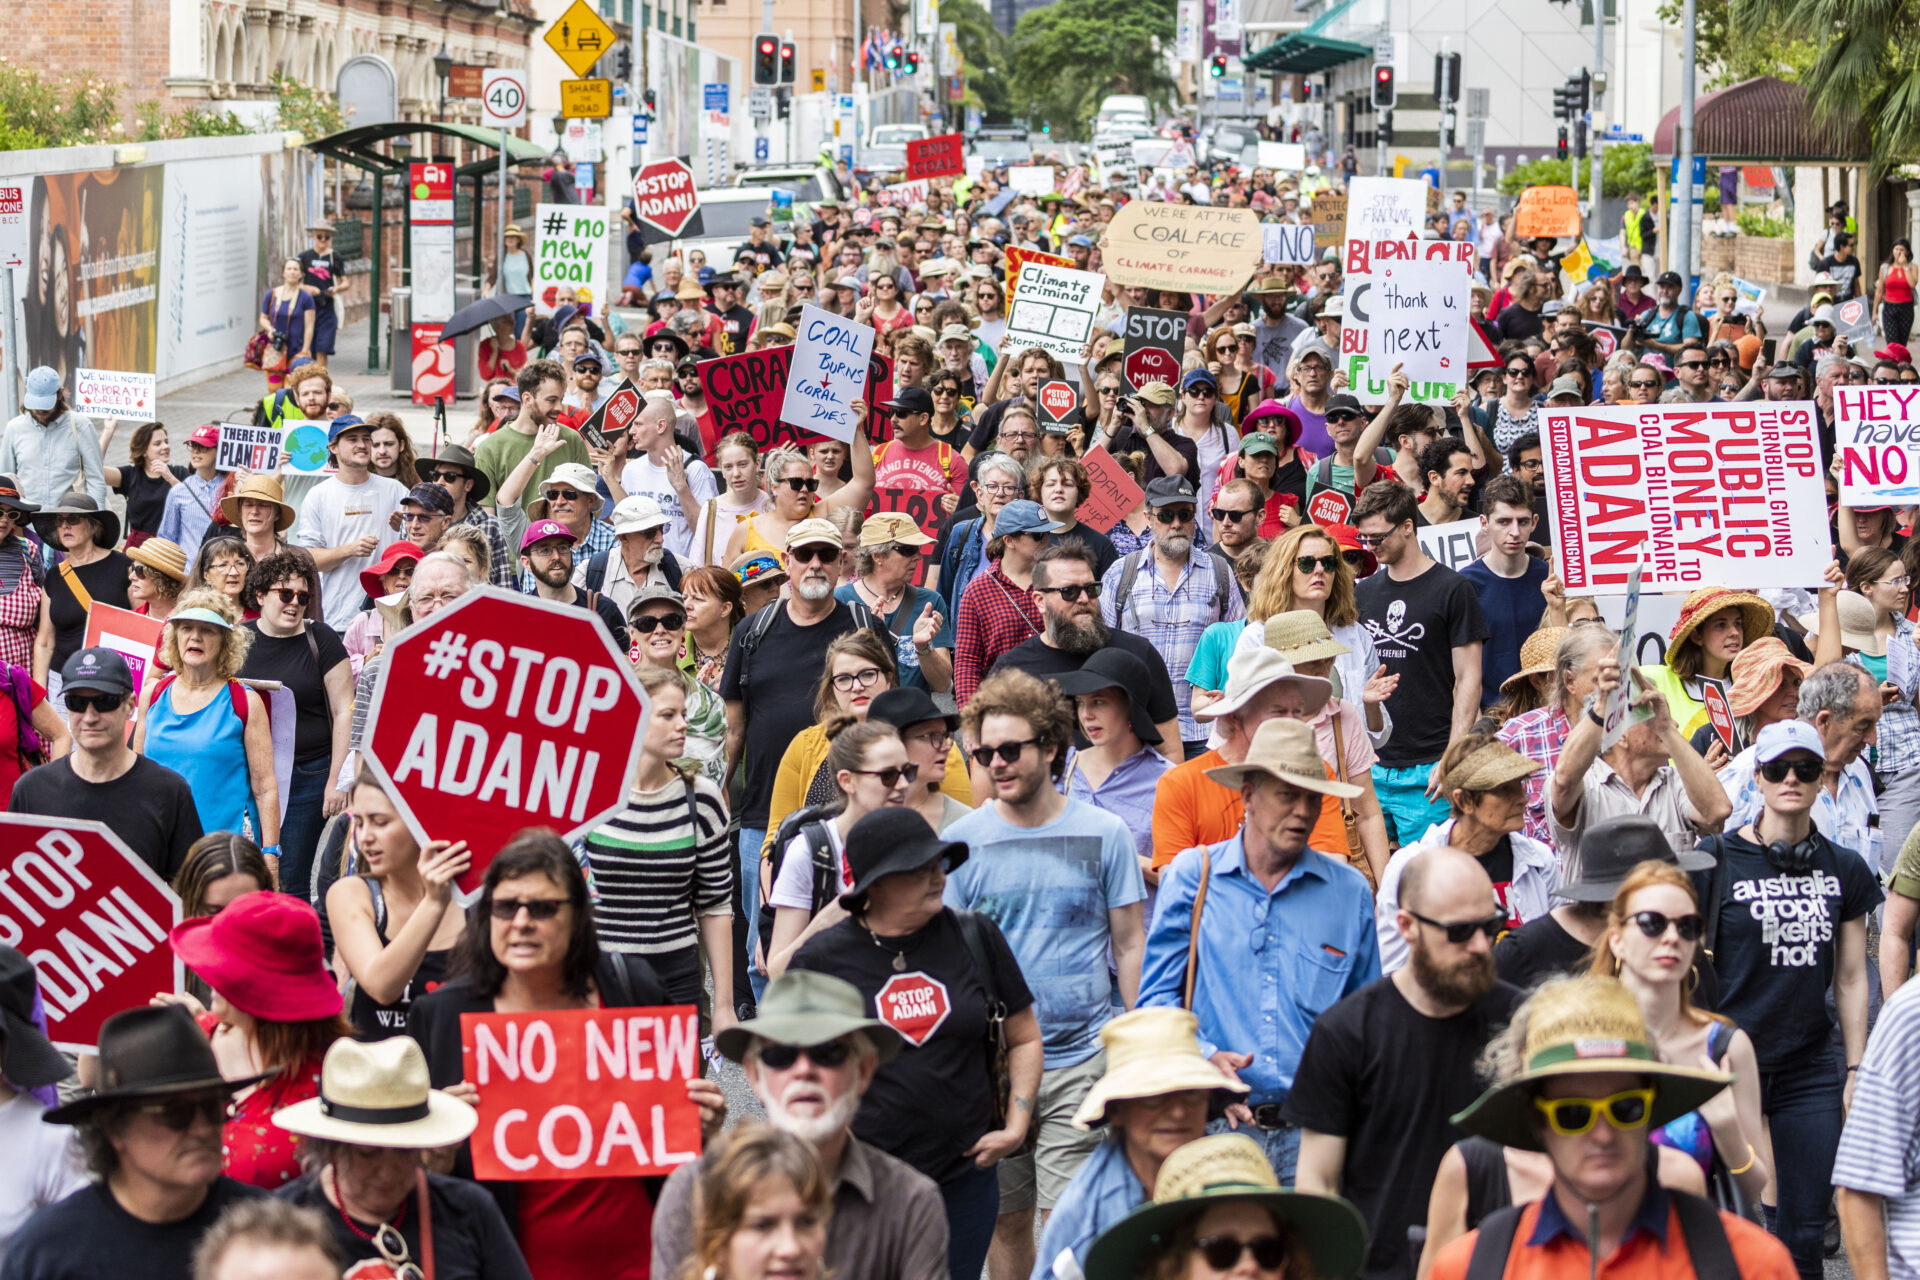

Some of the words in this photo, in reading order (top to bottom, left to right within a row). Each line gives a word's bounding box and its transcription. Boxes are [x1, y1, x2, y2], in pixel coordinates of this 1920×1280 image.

[489, 88, 519, 108] 40
[568, 84, 602, 94] SHARE
[572, 104, 600, 113] ROAD
[919, 141, 951, 157] END
[914, 157, 957, 175] COAL
[0, 189, 18, 199] BUS
[636, 171, 689, 196] #STOP
[641, 192, 693, 217] ADANI
[1313, 200, 1346, 212] PROTEC
[1373, 195, 1400, 207] STOP
[574, 218, 605, 238] no
[1195, 211, 1214, 221] AT
[1218, 212, 1243, 223] THE
[1326, 213, 1343, 221] OUR
[541, 239, 593, 260] new
[1167, 250, 1190, 259] OF
[1280, 226, 1314, 262] NO
[540, 261, 593, 283] coal
[1117, 258, 1173, 272] CLIMATE
[1023, 267, 1091, 293] Climate
[1018, 284, 1086, 305] criminal
[807, 320, 862, 357] COAL
[1128, 314, 1187, 341] STOP
[819, 352, 864, 384] BURNS
[1141, 354, 1163, 367] NO
[79, 382, 150, 397] CORPORATE
[94, 395, 132, 405] GREED
[796, 379, 844, 404] CORAL
[1047, 389, 1071, 399] #STOP
[712, 394, 764, 427] NOT
[1046, 397, 1070, 408] ADANI
[1839, 388, 1920, 421] HEY
[609, 404, 627, 424] ADANI
[810, 403, 848, 425] DIES
[223, 427, 254, 442] THERE
[255, 431, 267, 443] IS
[268, 432, 282, 444] NO
[1639, 414, 1664, 461] COAL
[1780, 410, 1816, 477] STOP
[219, 441, 267, 470] PLANET
[267, 446, 279, 470] B
[1759, 409, 1786, 495] TURNBULL
[1843, 445, 1907, 486] NO
[1086, 461, 1131, 510] ADANI
[1663, 411, 1723, 558] MONEY
[1711, 411, 1771, 558] PUBLIC
[1318, 497, 1345, 512] #STOP
[1552, 420, 1582, 584] STOPADANI.COM/LONGMAN
[1575, 416, 1653, 585] ADANI
[1314, 507, 1341, 523] ADANI
[1646, 466, 1677, 583] BILLIONAIRE
[1770, 500, 1793, 557] GIVING
[1679, 558, 1702, 582] TO
[125, 655, 144, 672] NEW
[423, 630, 622, 734] #STOP
[393, 712, 600, 823] ADANI
[1732, 869, 1842, 901] australia
[888, 986, 934, 1005] #STOP
[893, 1000, 937, 1021] ADANI
[474, 1020, 557, 1085] NO
[585, 1014, 699, 1081] NEW
[493, 1101, 697, 1171] COAL
